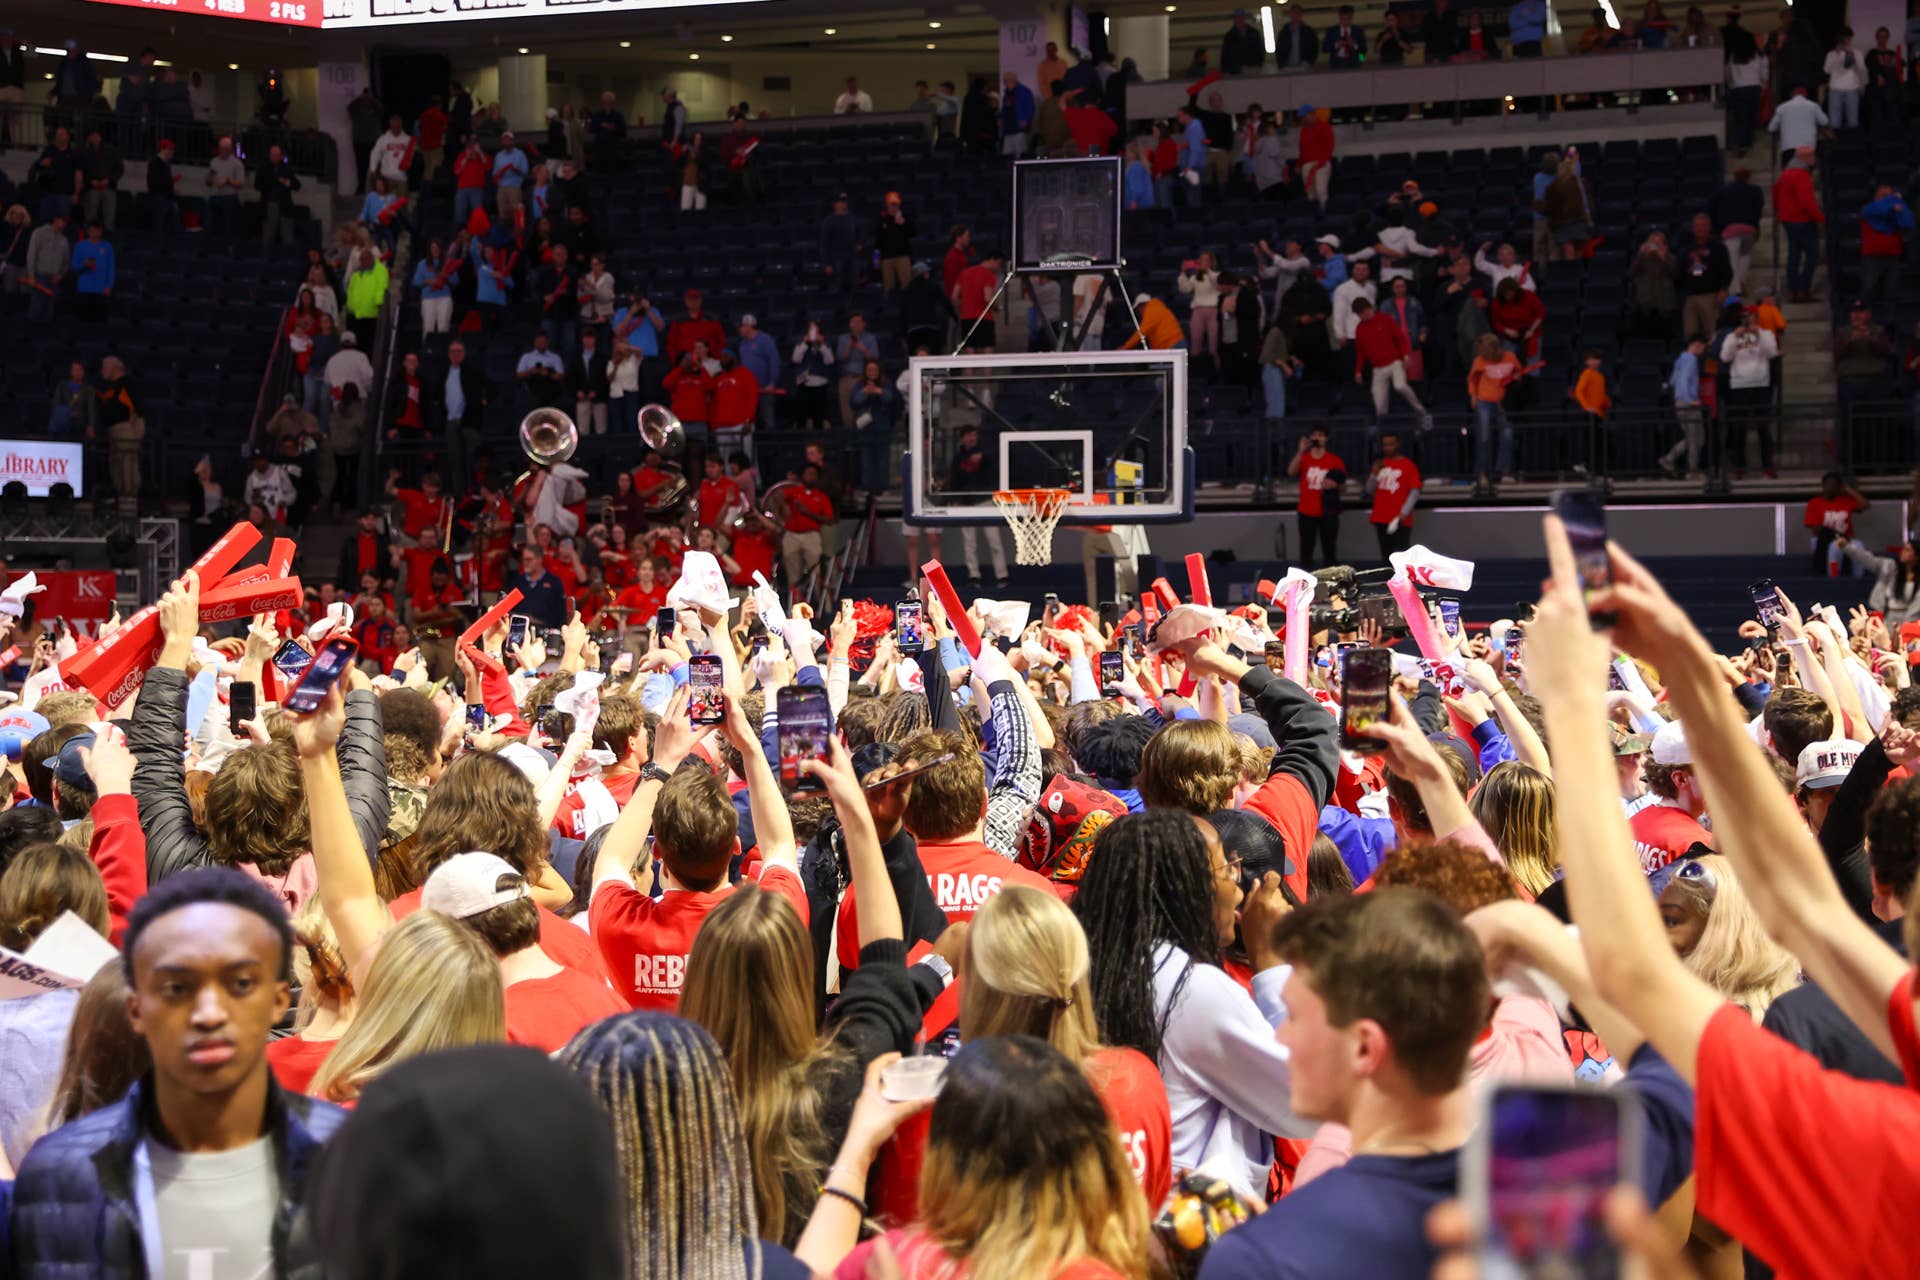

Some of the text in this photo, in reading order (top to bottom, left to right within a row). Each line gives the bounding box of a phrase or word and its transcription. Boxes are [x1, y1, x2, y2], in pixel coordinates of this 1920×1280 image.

[270, 1, 281, 18] 2
[282, 3, 306, 20] FLS
[200, 602, 237, 619] ca-Cola
[250, 592, 297, 612] Coca-Cola
[107, 664, 145, 708] Coca-Cola
[1817, 751, 1858, 769] OLE MIS
